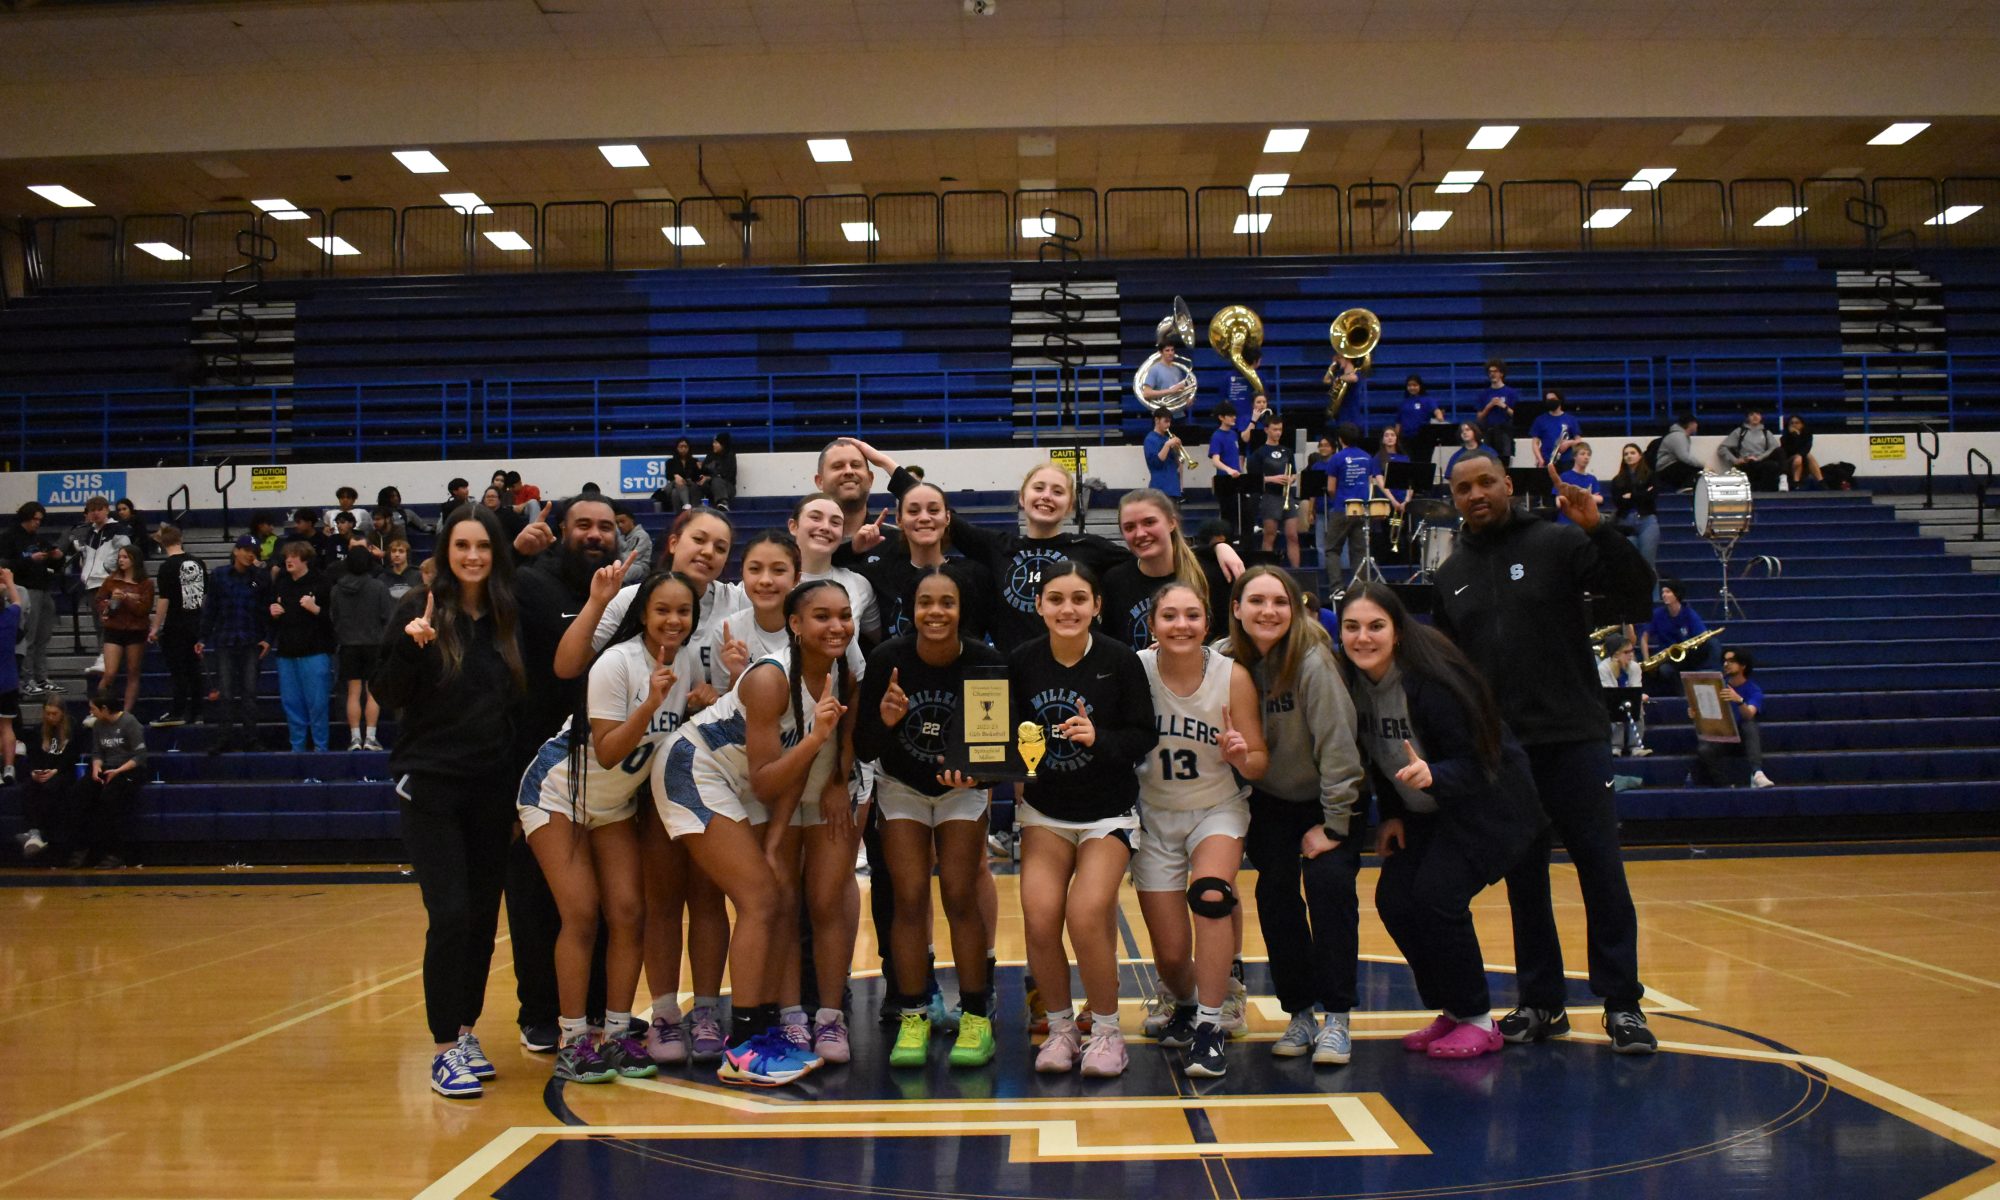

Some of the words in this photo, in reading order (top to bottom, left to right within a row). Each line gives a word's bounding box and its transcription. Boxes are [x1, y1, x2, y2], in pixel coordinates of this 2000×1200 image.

[1051, 450, 1086, 458] CAUTIN
[63, 474, 103, 489] SHS
[1028, 571, 1042, 583] 14
[1510, 564, 1525, 581] S
[922, 721, 941, 737] 22
[1158, 748, 1200, 780] 13
